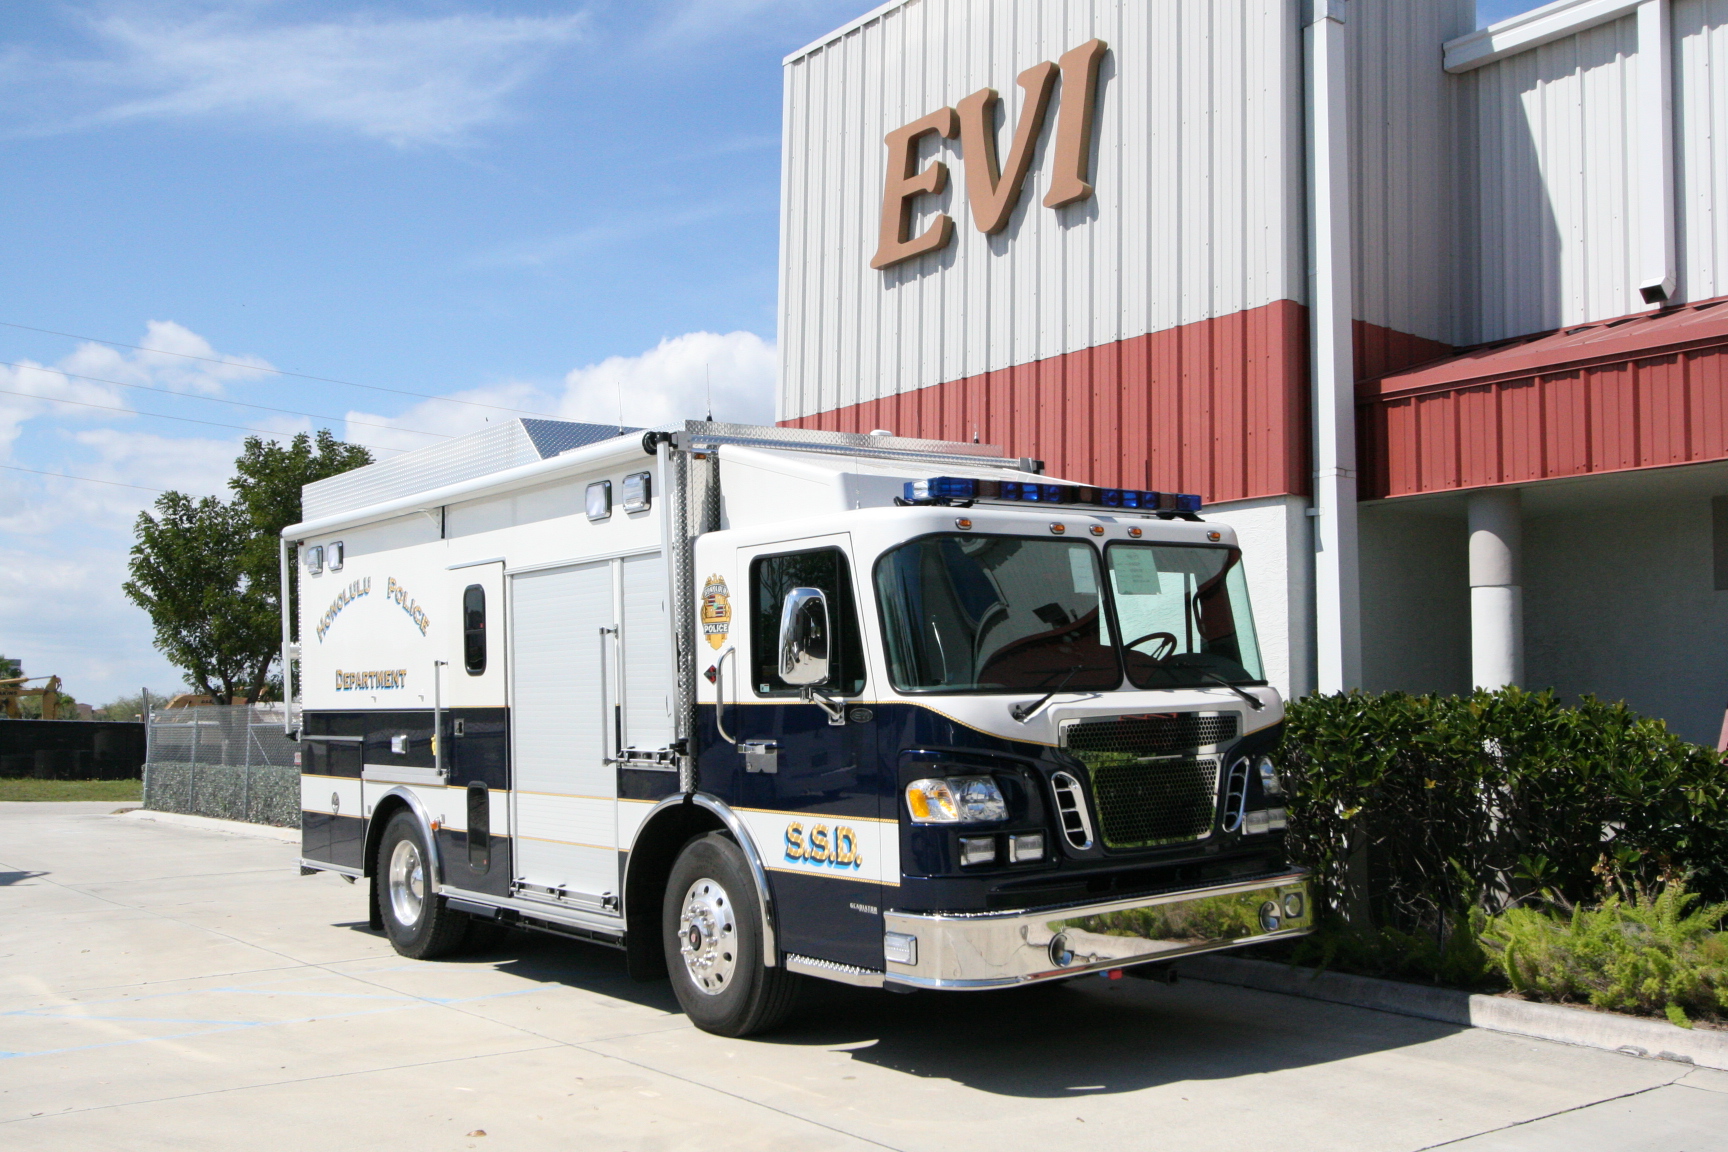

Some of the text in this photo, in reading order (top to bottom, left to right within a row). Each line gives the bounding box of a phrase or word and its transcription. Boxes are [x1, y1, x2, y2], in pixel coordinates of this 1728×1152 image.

[870, 38, 1108, 270] EVI
[316, 576, 430, 645] HONOLULU POLICE
[705, 624, 728, 633] POLICE
[335, 669, 407, 692] DEPARTMENT
[784, 821, 863, 871] S.S.D.
